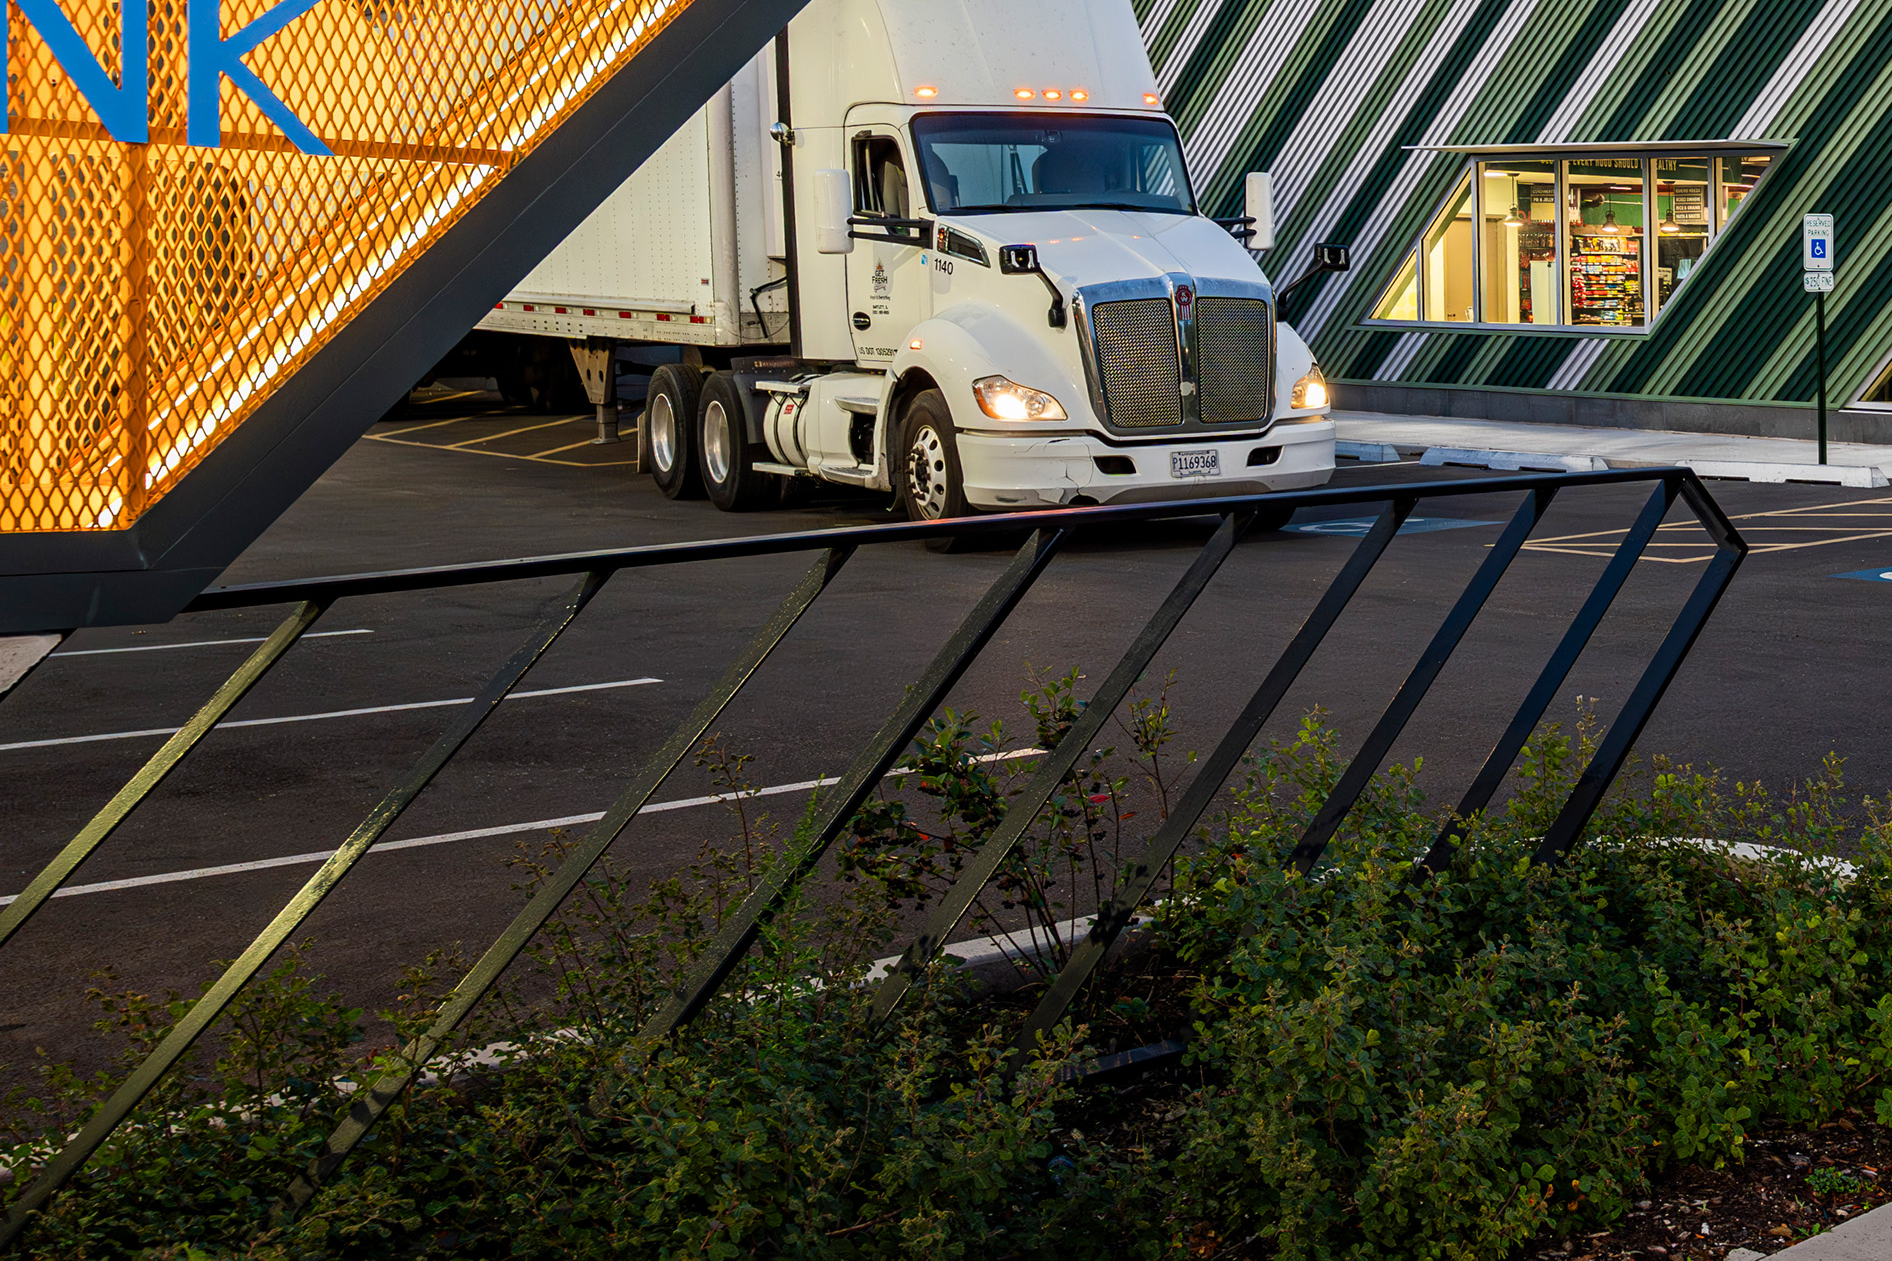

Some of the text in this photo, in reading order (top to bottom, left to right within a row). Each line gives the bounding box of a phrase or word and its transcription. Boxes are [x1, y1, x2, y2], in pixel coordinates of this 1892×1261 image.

[934, 258, 954, 275] 1140
[875, 269, 884, 277] GET
[872, 276, 888, 284] FRESH
[1821, 276, 1832, 287] FINE
[1172, 455, 1216, 470] P1169368
